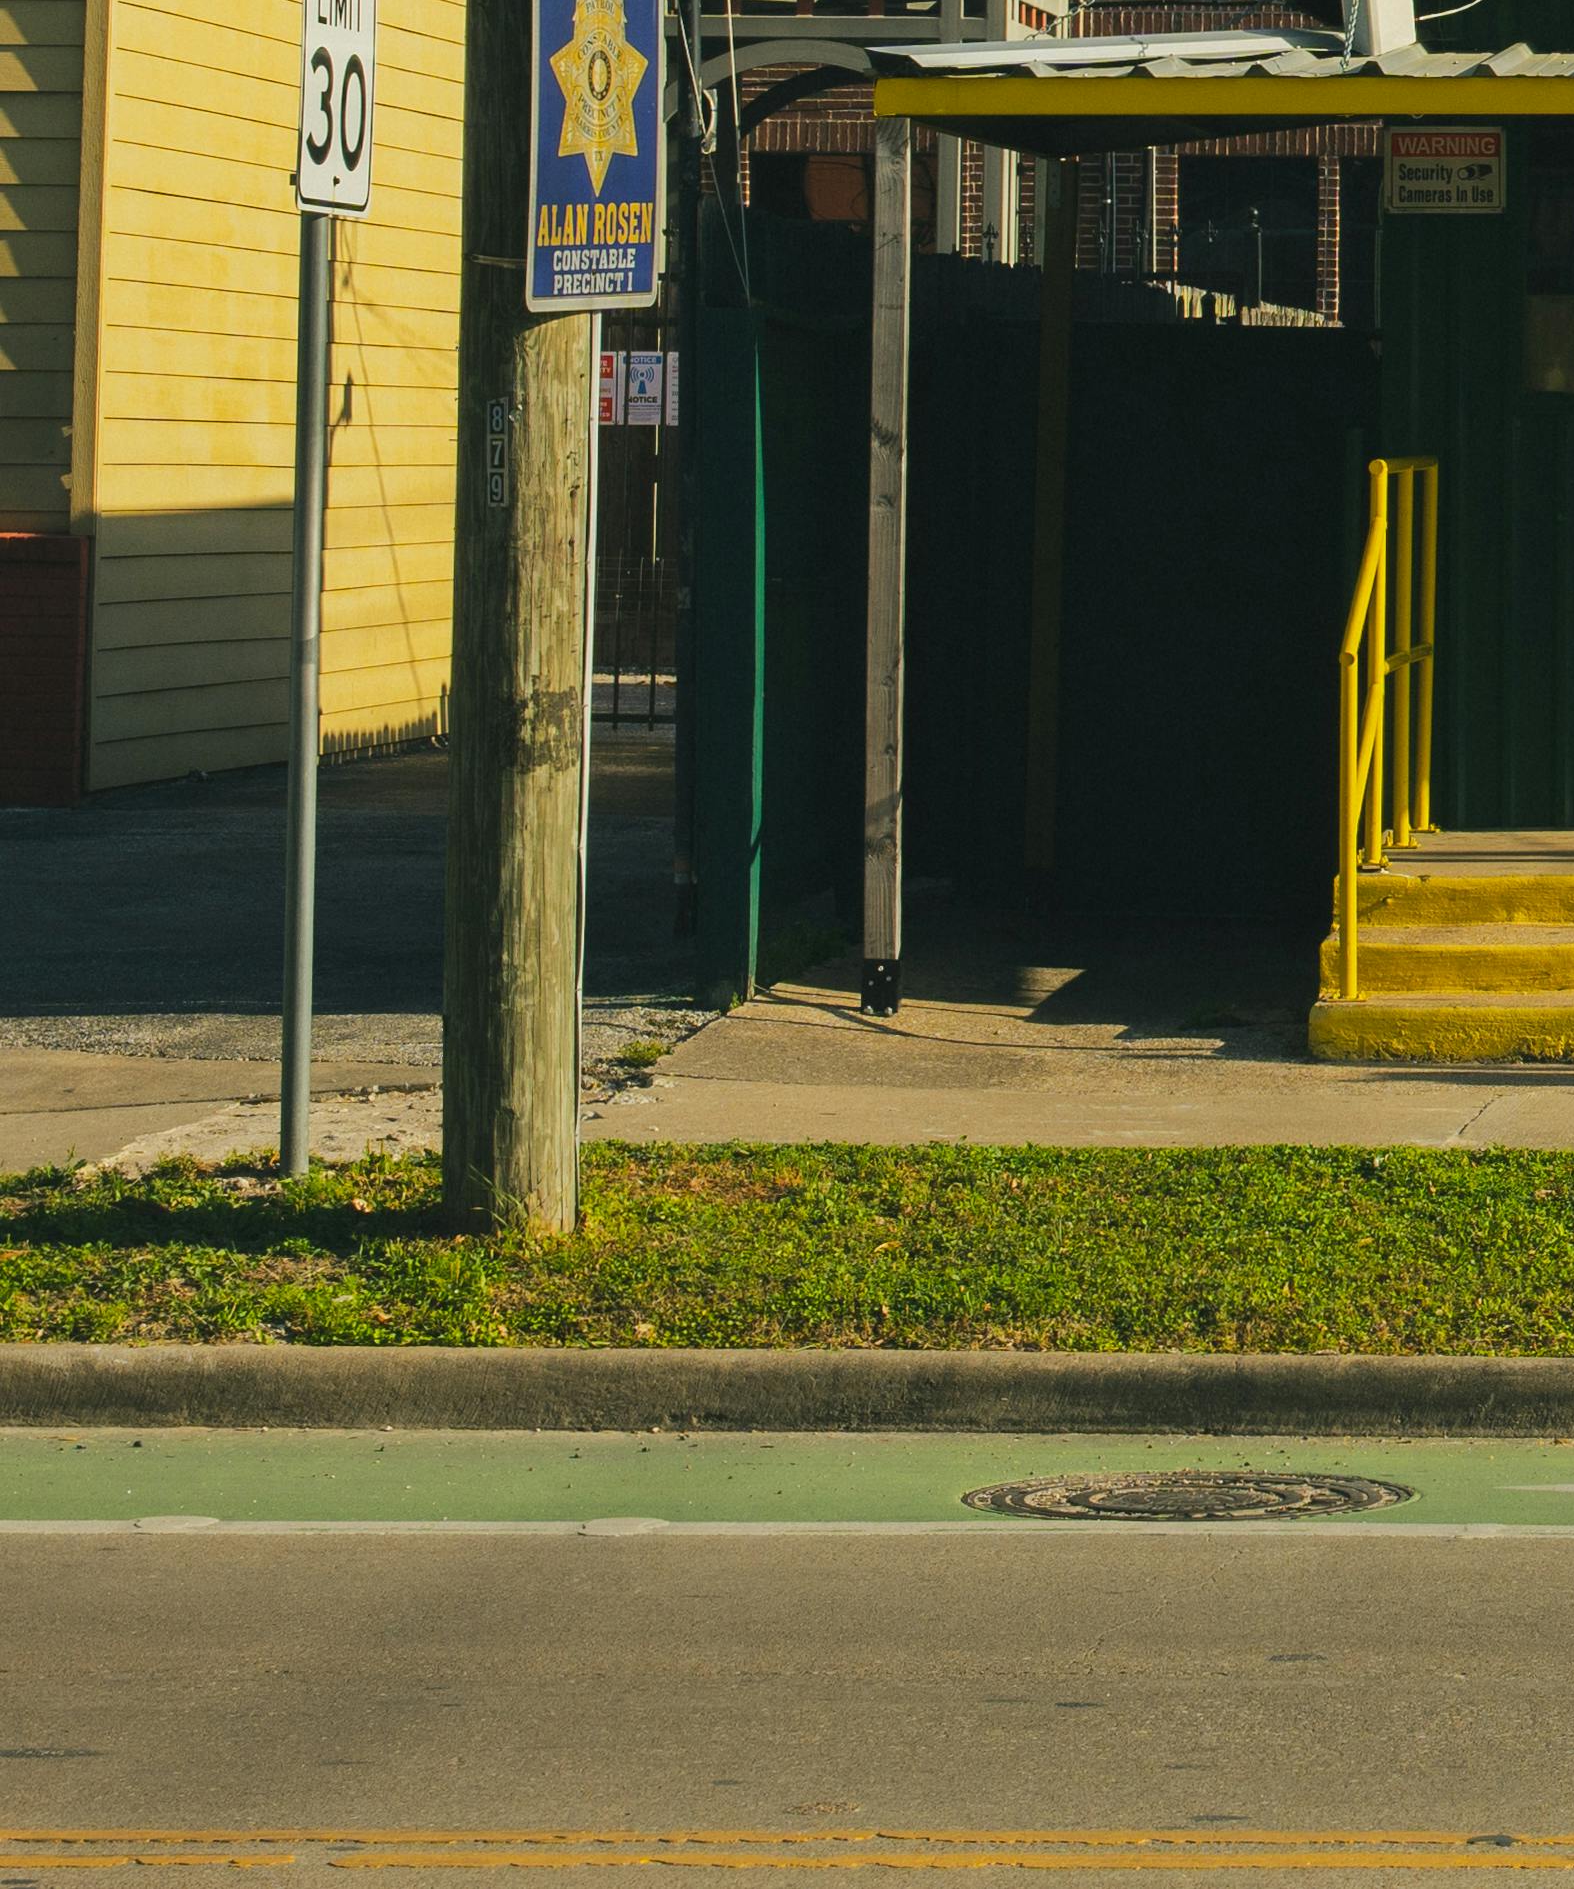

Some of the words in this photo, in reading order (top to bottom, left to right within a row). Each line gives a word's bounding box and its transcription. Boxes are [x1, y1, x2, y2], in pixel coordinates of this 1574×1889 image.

[306, 46, 366, 172] 30
[1398, 136, 1496, 155] WARNING
[1398, 163, 1453, 184] Security
[1398, 185, 1452, 203] Cameras
[1456, 185, 1468, 203] In
[1471, 185, 1494, 203] Use
[537, 204, 589, 247] ALAN
[593, 202, 653, 245] ROSEN
[553, 248, 636, 272] CONSTABLE
[553, 272, 625, 295] PRECINCT
[627, 271, 633, 292] 1
[491, 405, 504, 502] 879
